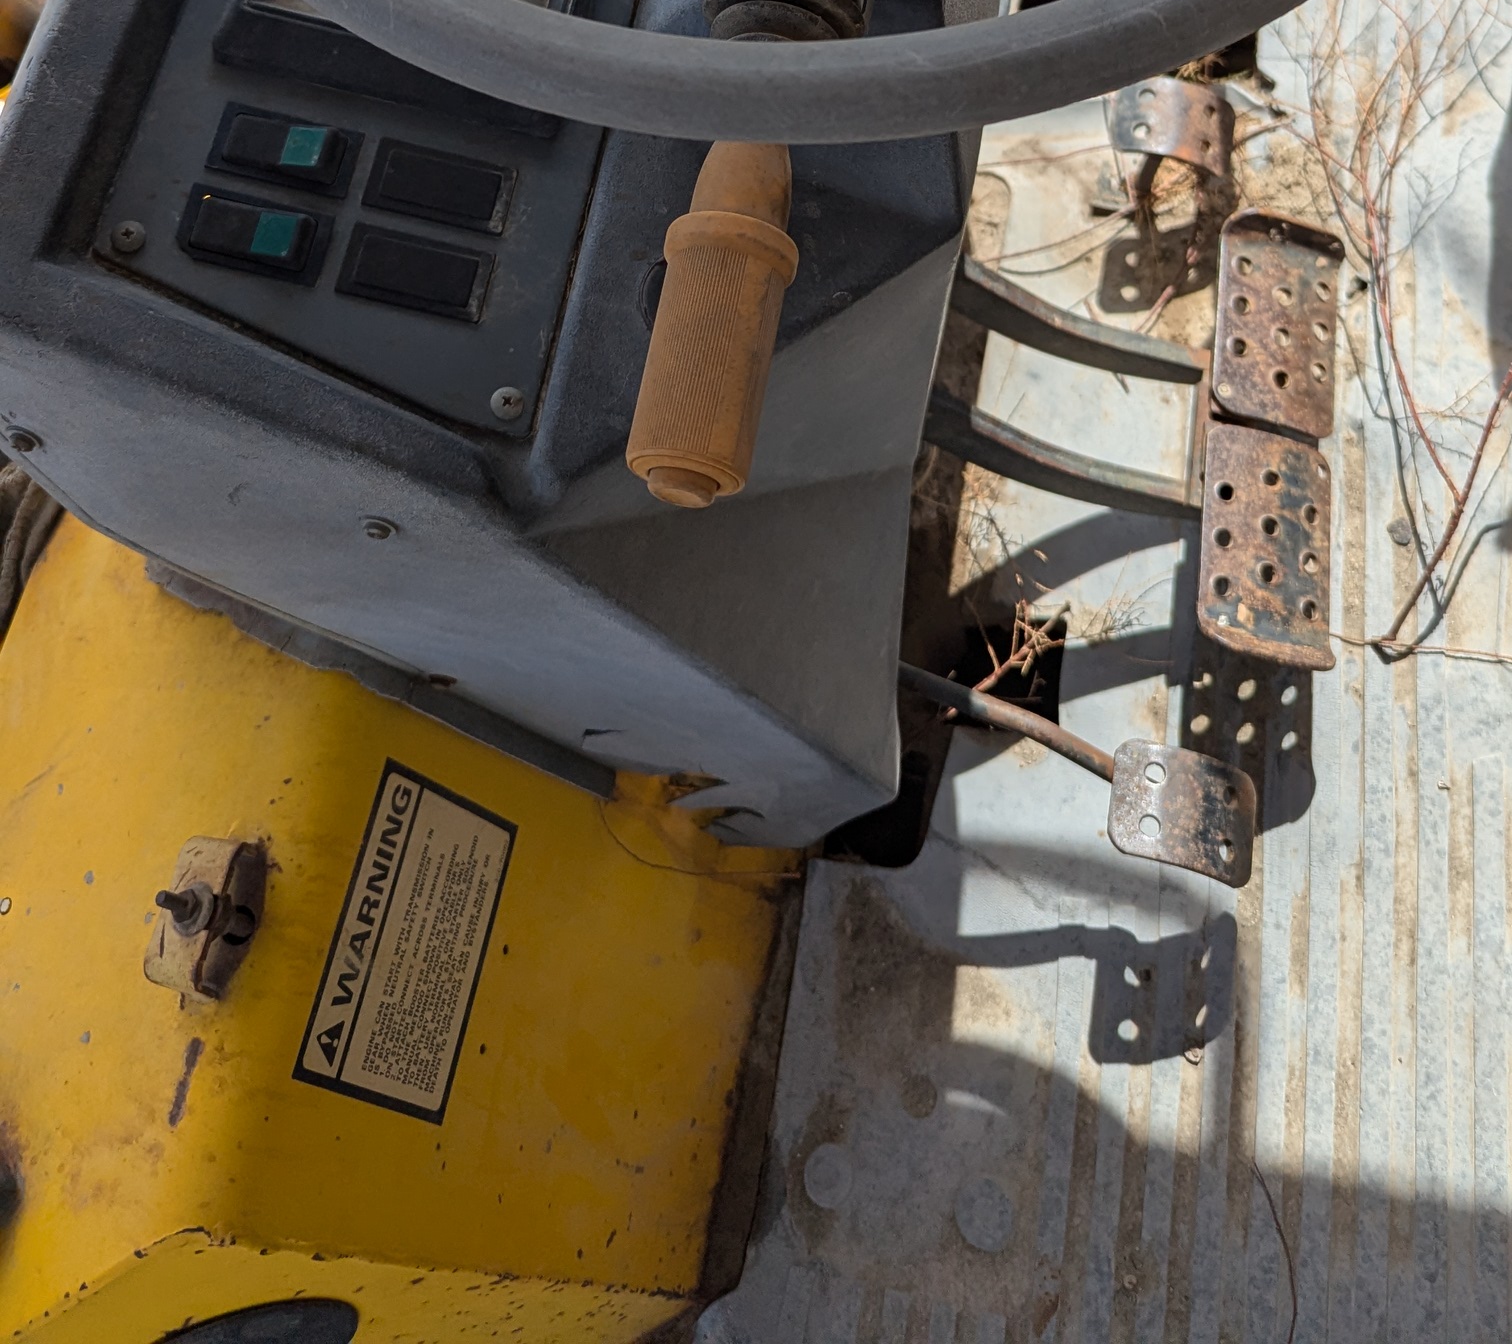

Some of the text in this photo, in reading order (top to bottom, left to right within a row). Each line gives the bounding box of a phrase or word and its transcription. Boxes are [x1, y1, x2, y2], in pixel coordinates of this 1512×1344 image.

[331, 783, 412, 1007] WARNING
[361, 1028, 377, 1071] ENGINE
[374, 1000, 385, 1024] CAN
[382, 959, 397, 996] START
[393, 926, 406, 956] WITH
[402, 842, 429, 922] TRANSMISSION
[367, 856, 431, 1073] GEAR WHEN NEUTRAL SAFETY SWITCH
[388, 1019, 399, 1042] NOT
[396, 962, 414, 1015] CONNECT
[411, 915, 427, 958] ACROSS
[424, 852, 445, 912] TERMINALS
[394, 1021, 410, 1065] ATTACH
[407, 967, 425, 1016] BOOSTER
[422, 906, 441, 964] BATTERIES
[439, 842, 459, 902] ACCORDING
[416, 977, 434, 1029] CONNECT
[431, 926, 448, 974] POSITIVE
[445, 890, 457, 923] CABLE
[455, 859, 466, 886] ONLY
[423, 1042, 441, 1091] MACHINE
[455, 949, 465, 973] CAN
[462, 911, 475, 946] CAUSE
[472, 871, 485, 908] INJURY
[423, 1028, 432, 1049] USE
[430, 977, 446, 1023] NORMAL
[443, 921, 461, 973] STARTING
[401, 1040, 411, 1061] THE
[408, 989, 425, 1035] METHOD
[422, 944, 437, 985] SHOWN
[412, 1017, 430, 1065] BATTERY
[427, 958, 445, 1012] TERMINAL
[418, 1058, 430, 1090] FROM
[429, 1057, 442, 1093] DEATH
[444, 977, 463, 1034] OPERATOR
[460, 950, 470, 973] AND
